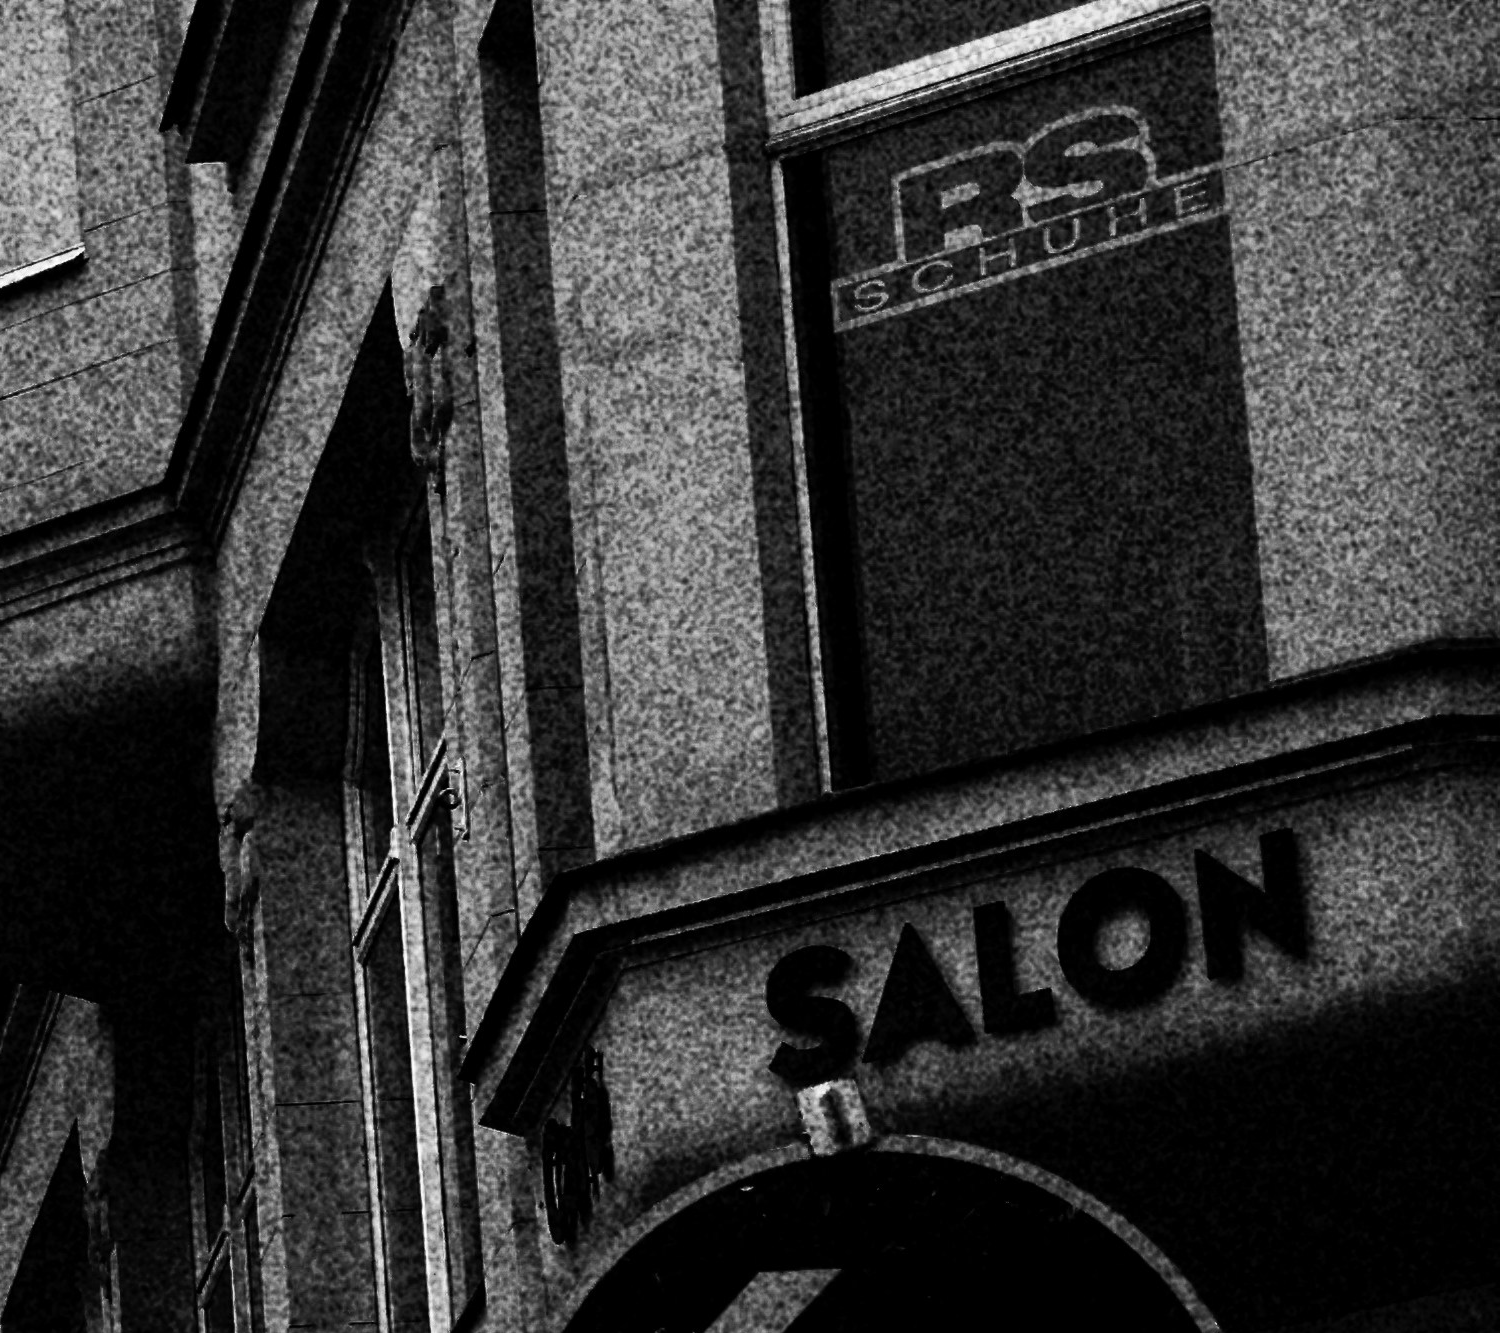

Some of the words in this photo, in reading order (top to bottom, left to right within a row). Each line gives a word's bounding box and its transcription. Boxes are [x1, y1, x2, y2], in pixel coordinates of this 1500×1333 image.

[853, 180, 1213, 314] SCHUHE
[893, 106, 1157, 264] RS
[764, 827, 1307, 1082] SALON
